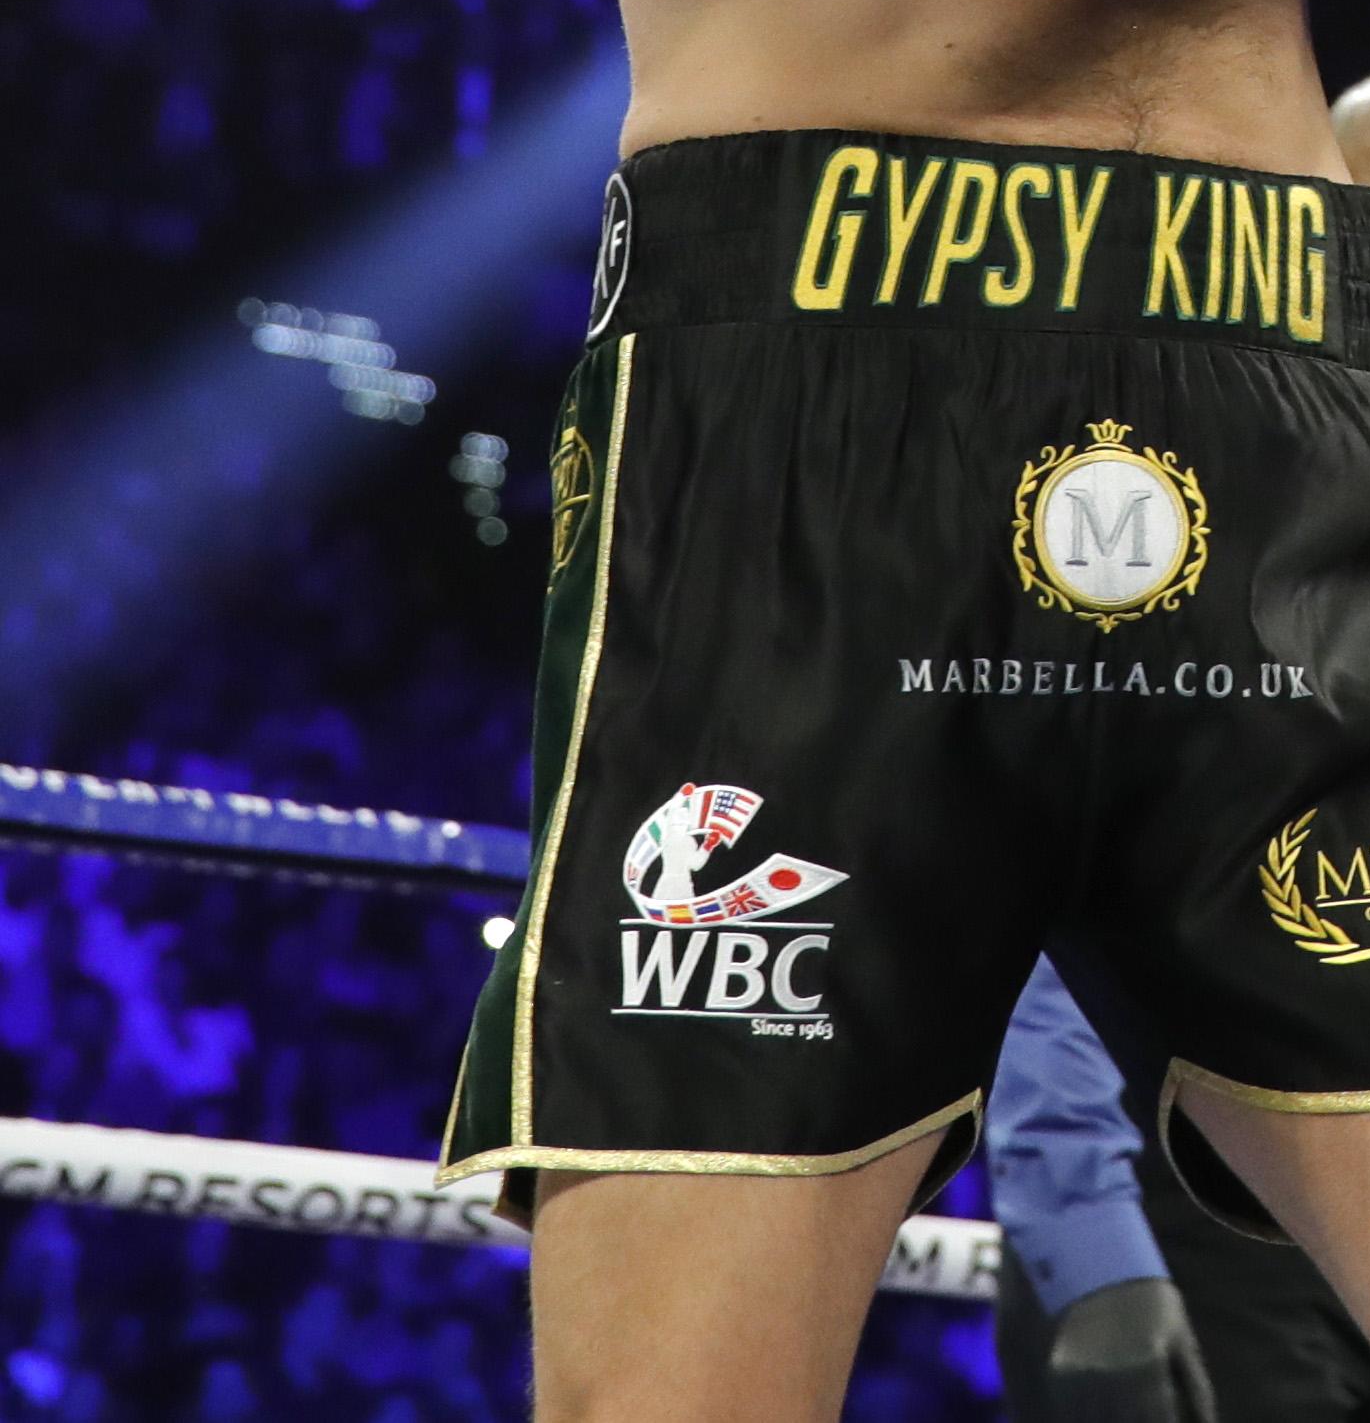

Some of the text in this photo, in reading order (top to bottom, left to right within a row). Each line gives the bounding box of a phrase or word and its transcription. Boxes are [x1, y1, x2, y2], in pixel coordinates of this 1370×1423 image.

[791, 144, 1328, 344] GYPSY KING
[1063, 487, 1154, 567] M
[897, 657, 1314, 699] MARBELLA.CO.UK
[620, 930, 831, 1012] WBC
[751, 1018, 834, 1041] Since 1963
